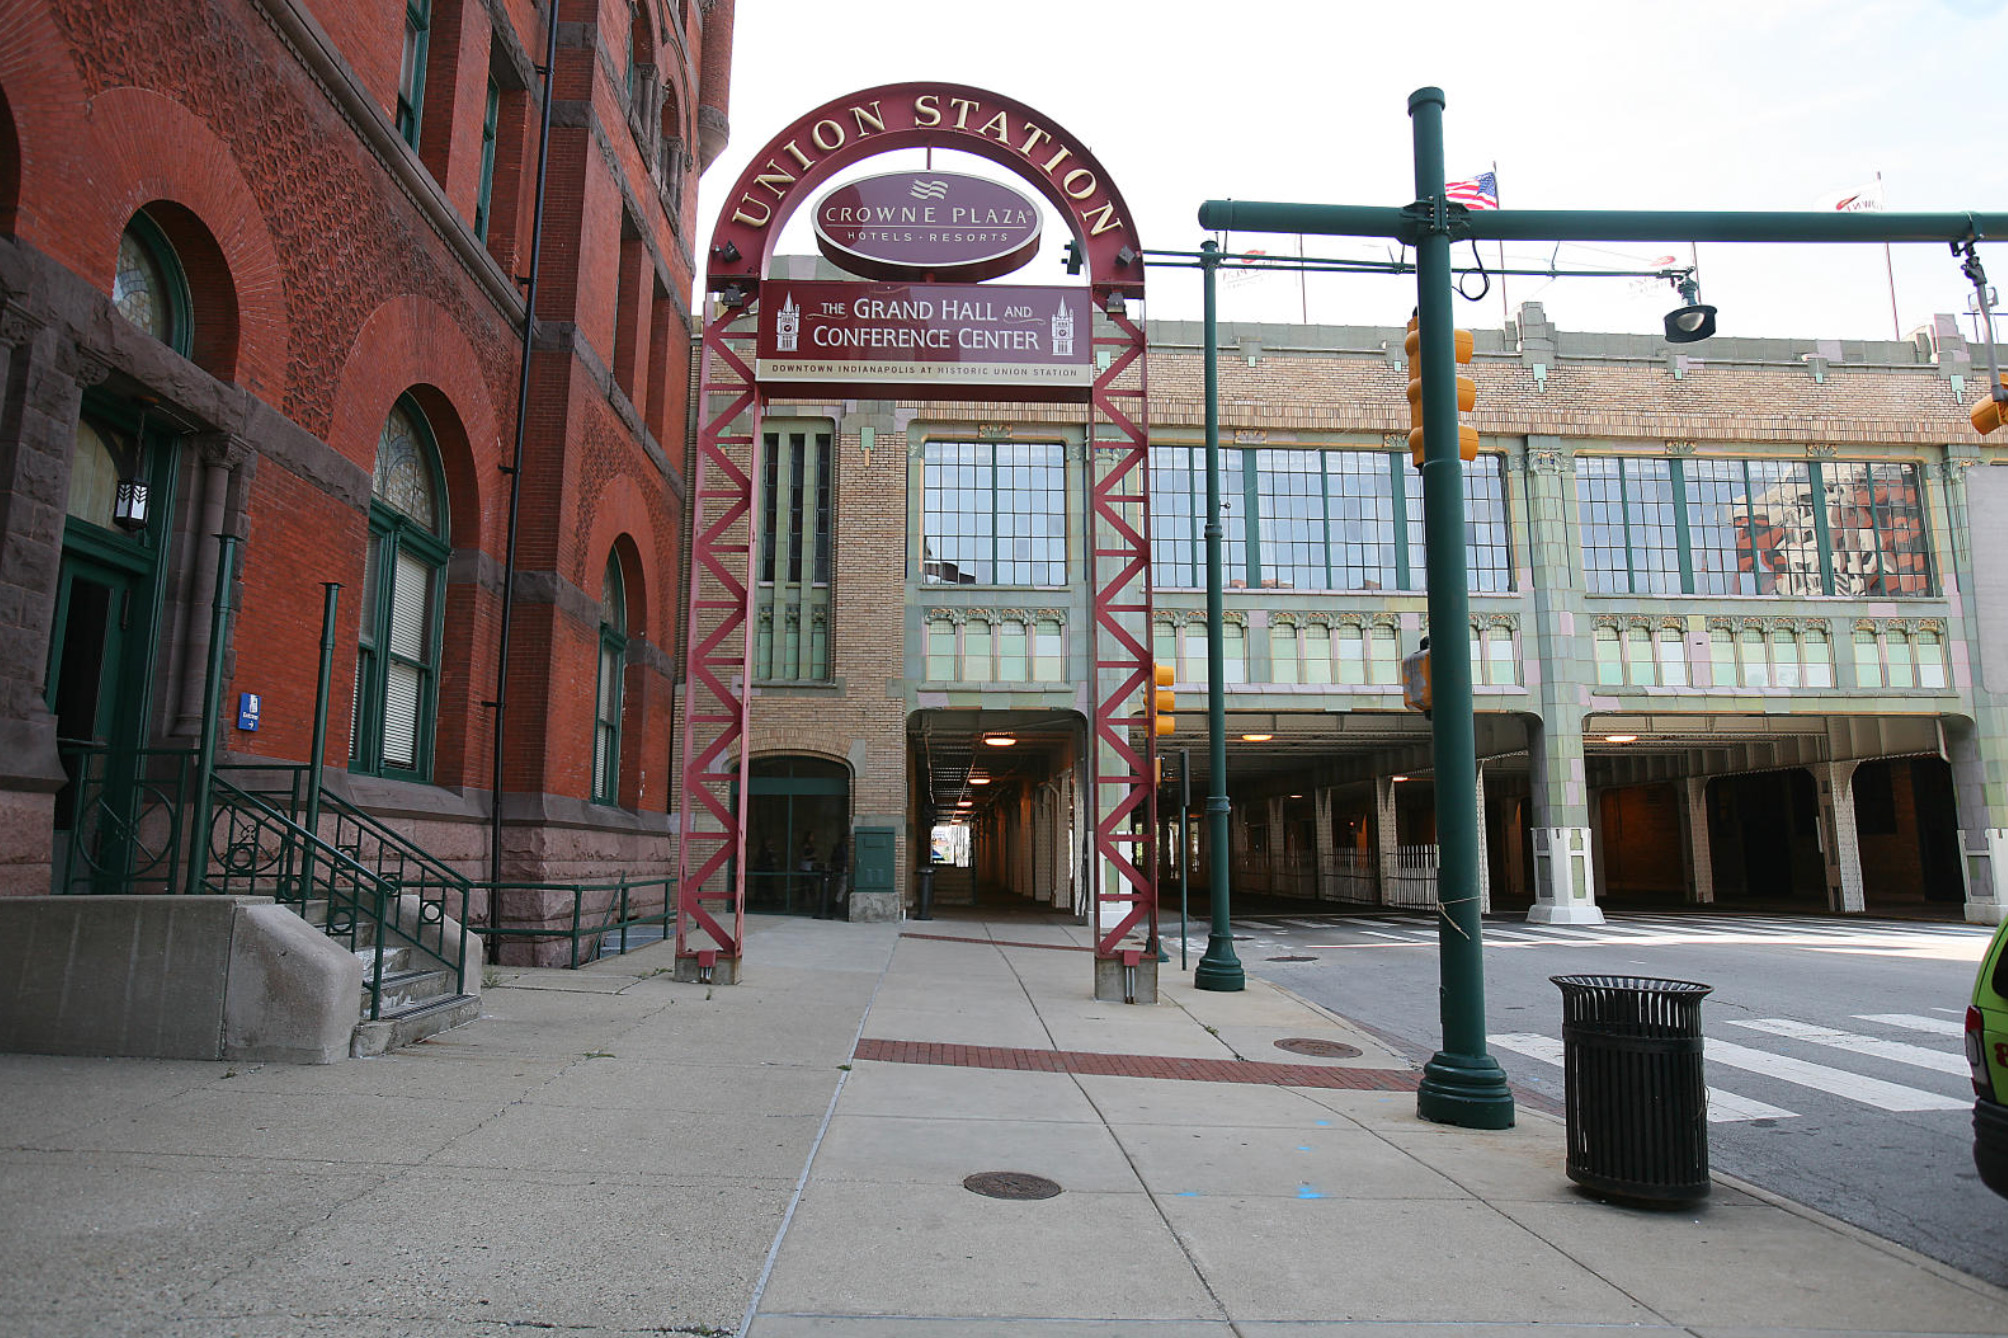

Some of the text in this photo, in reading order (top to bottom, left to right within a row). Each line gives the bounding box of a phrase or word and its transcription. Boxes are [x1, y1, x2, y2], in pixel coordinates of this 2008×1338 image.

[732, 95, 1124, 236] UNION STATION
[825, 207, 936, 223] CROWNE
[847, 231, 1008, 243] HOTELS RESORTS
[821, 298, 1033, 321] THE GRAND HALL AND
[813, 325, 1039, 350] CONFERENCE CENTER
[772, 364, 1077, 377] DOWNTOWN INDIANAPOLIS AT HISTORIC UNION STATION
